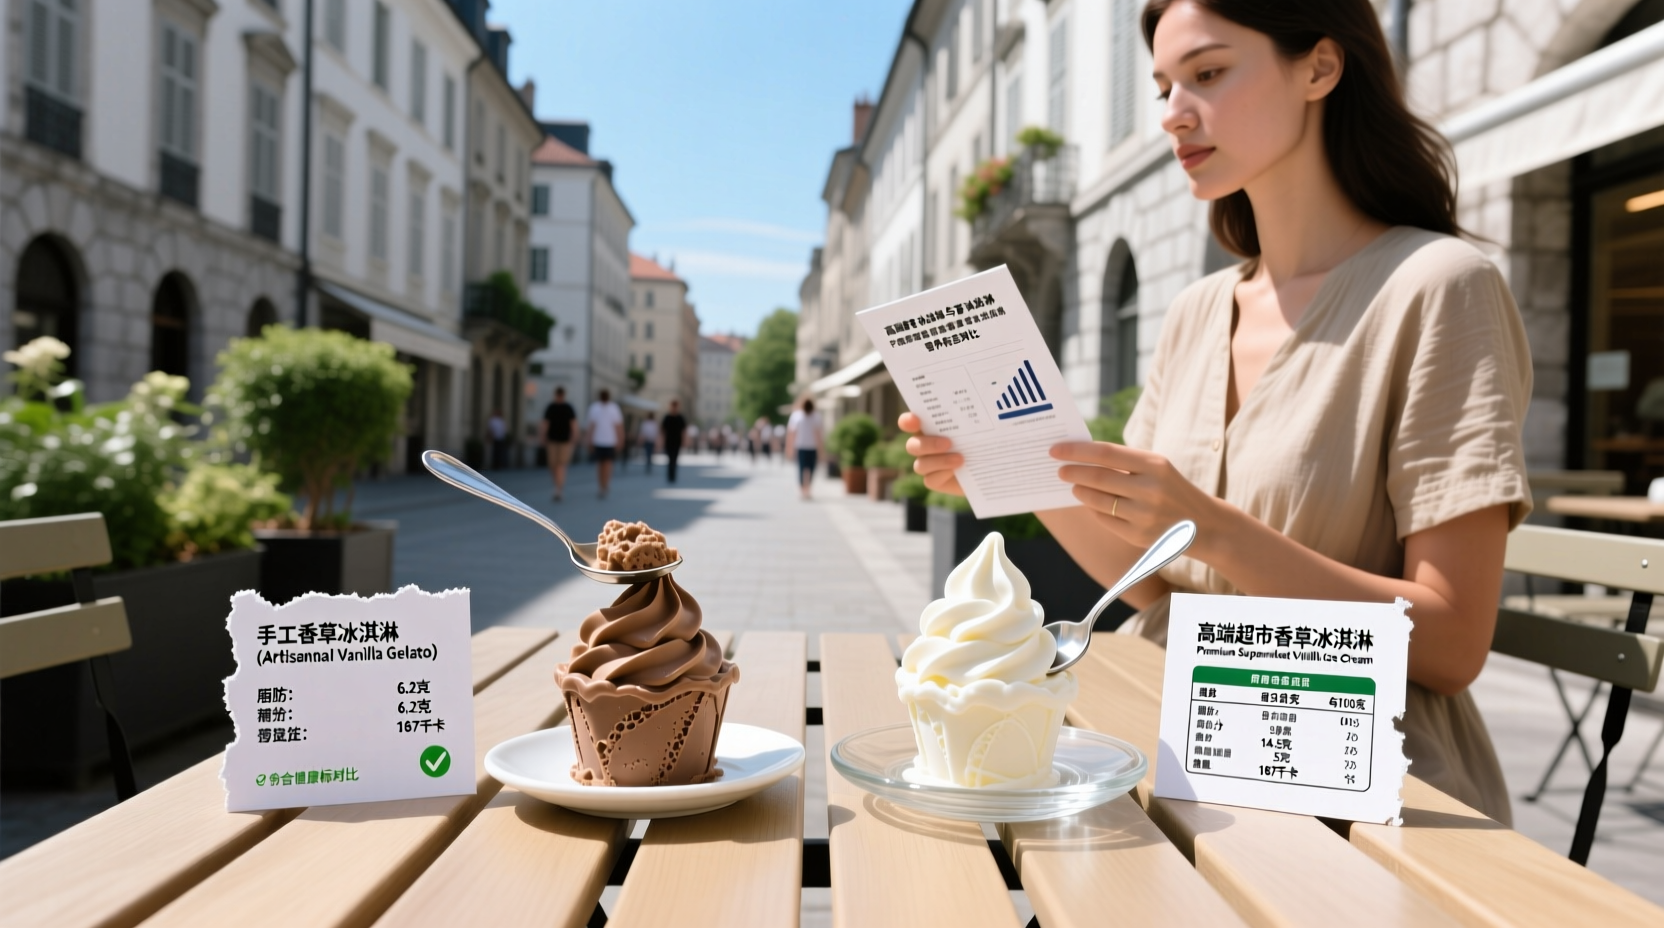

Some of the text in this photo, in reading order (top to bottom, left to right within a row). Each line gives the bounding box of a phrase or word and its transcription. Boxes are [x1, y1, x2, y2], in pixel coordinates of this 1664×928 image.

[257, 621, 399, 646] 手工香草冰淇淋
[1197, 622, 1374, 652] 高端超市香草冰淇淋
[386, 643, 438, 661] Gelato)
[397, 679, 431, 695] 6.2克
[396, 718, 446, 734] 167千卡
